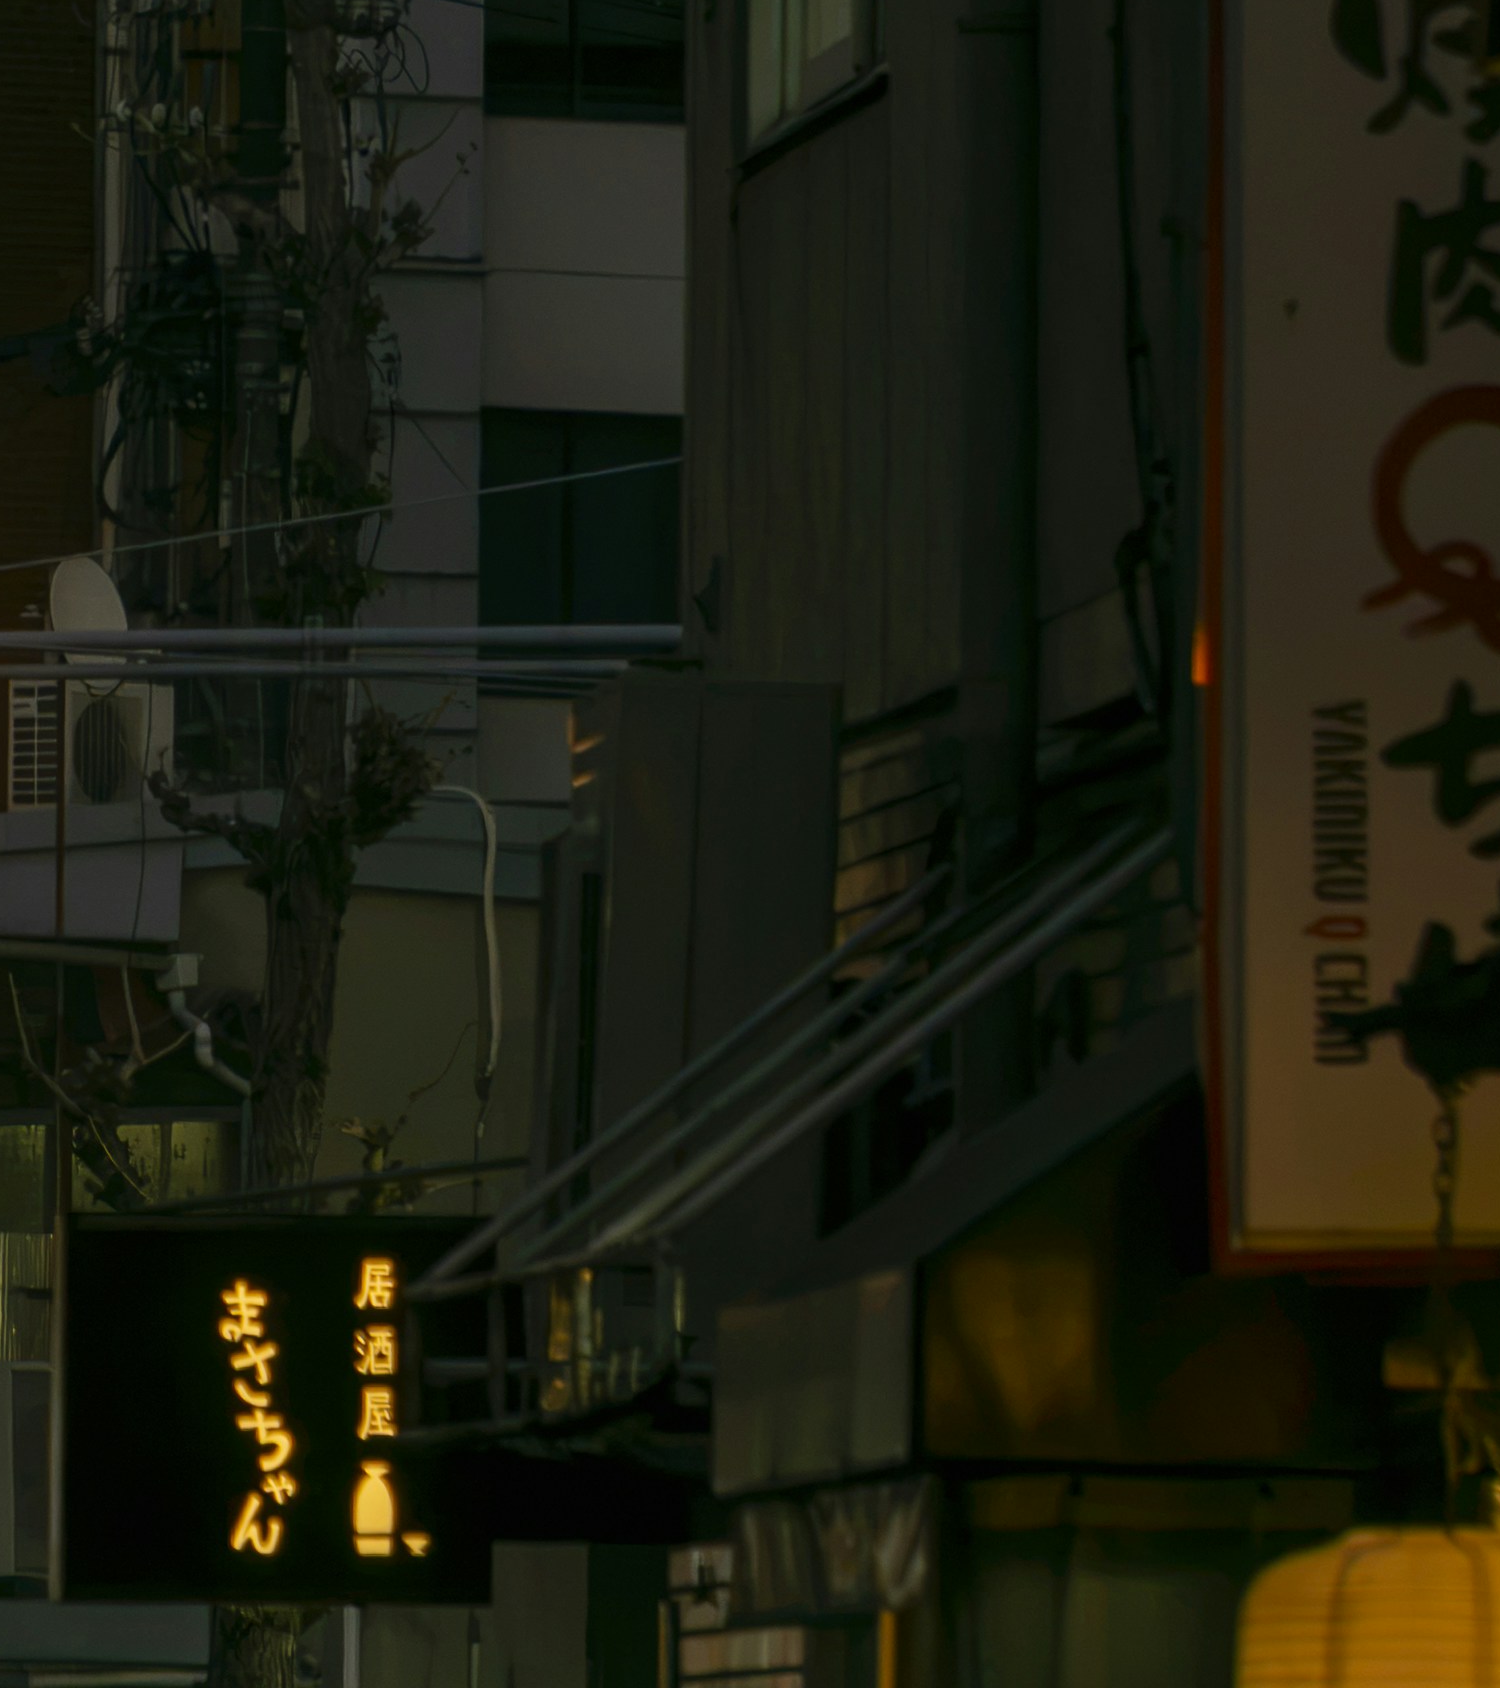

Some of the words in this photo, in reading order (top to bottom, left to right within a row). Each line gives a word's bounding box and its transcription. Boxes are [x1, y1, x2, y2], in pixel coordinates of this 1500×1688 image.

[1313, 699, 1368, 904] YAKINIKU
[1305, 916, 1367, 940] Q
[217, 1276, 297, 1558] まさちゃん
[352, 1255, 399, 1441] 居酒屋
